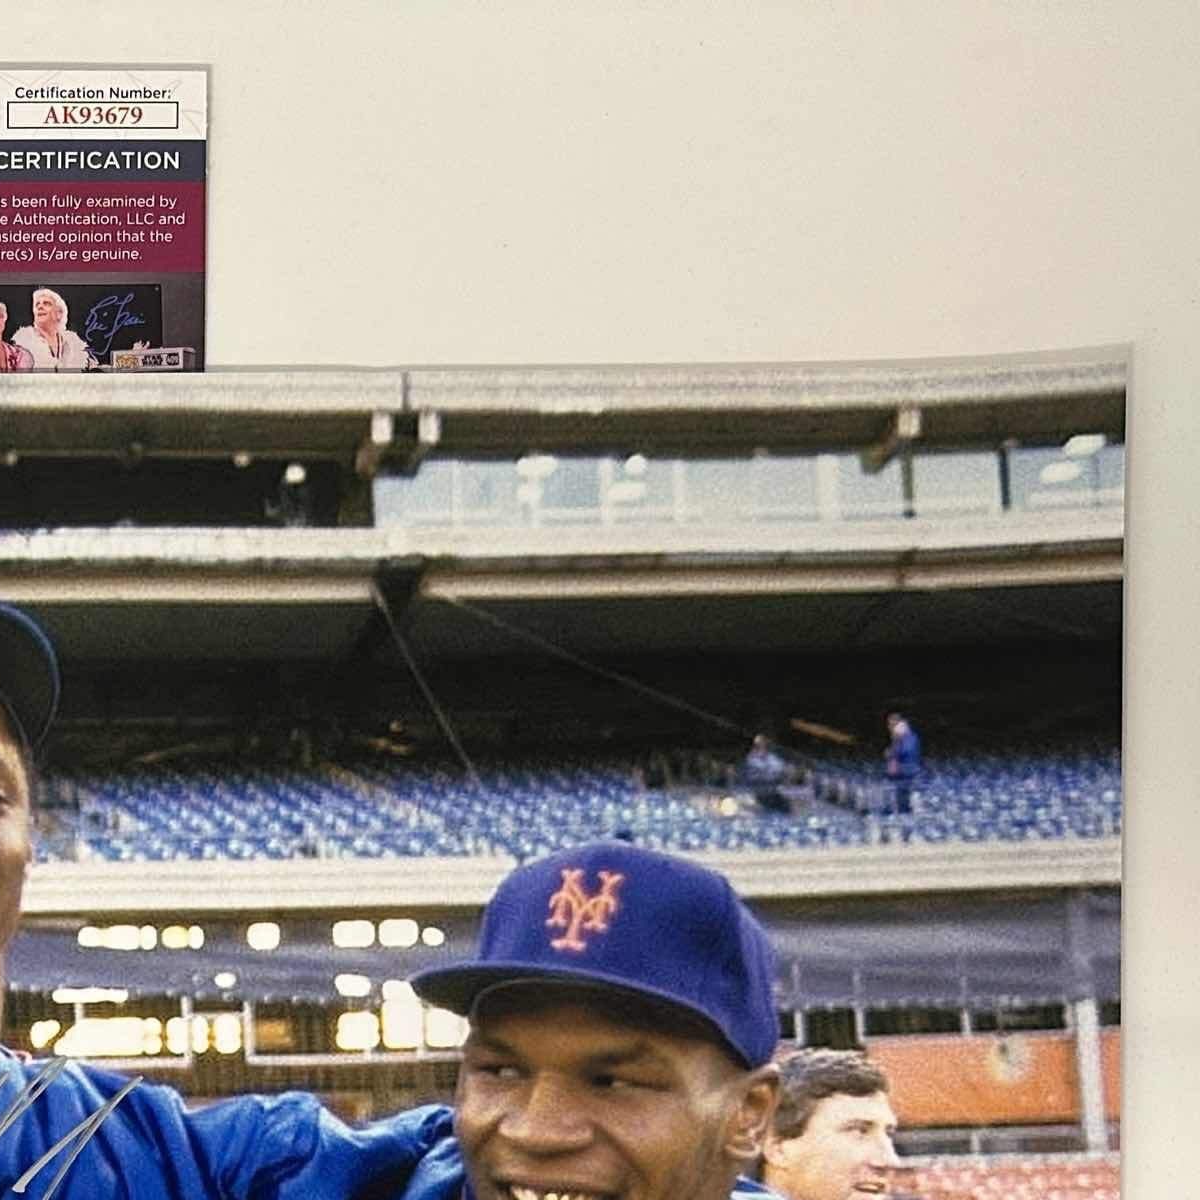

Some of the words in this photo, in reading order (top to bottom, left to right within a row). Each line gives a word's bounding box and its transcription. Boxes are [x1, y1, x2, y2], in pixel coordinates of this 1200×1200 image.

[14, 86, 104, 99] Certification
[109, 87, 172, 99] Number:
[44, 106, 143, 124] AK93679
[12, 195, 47, 208] been
[51, 194, 82, 210] fully
[86, 195, 155, 208] examined
[160, 194, 177, 210] by
[12, 212, 122, 226] Authentication,
[126, 212, 155, 225] LLC
[158, 212, 185, 225] and
[58, 230, 112, 244] opinion
[116, 229, 145, 243] that
[150, 229, 173, 243] the
[38, 247, 78, 262] is/are
[82, 248, 143, 263] genuine.
